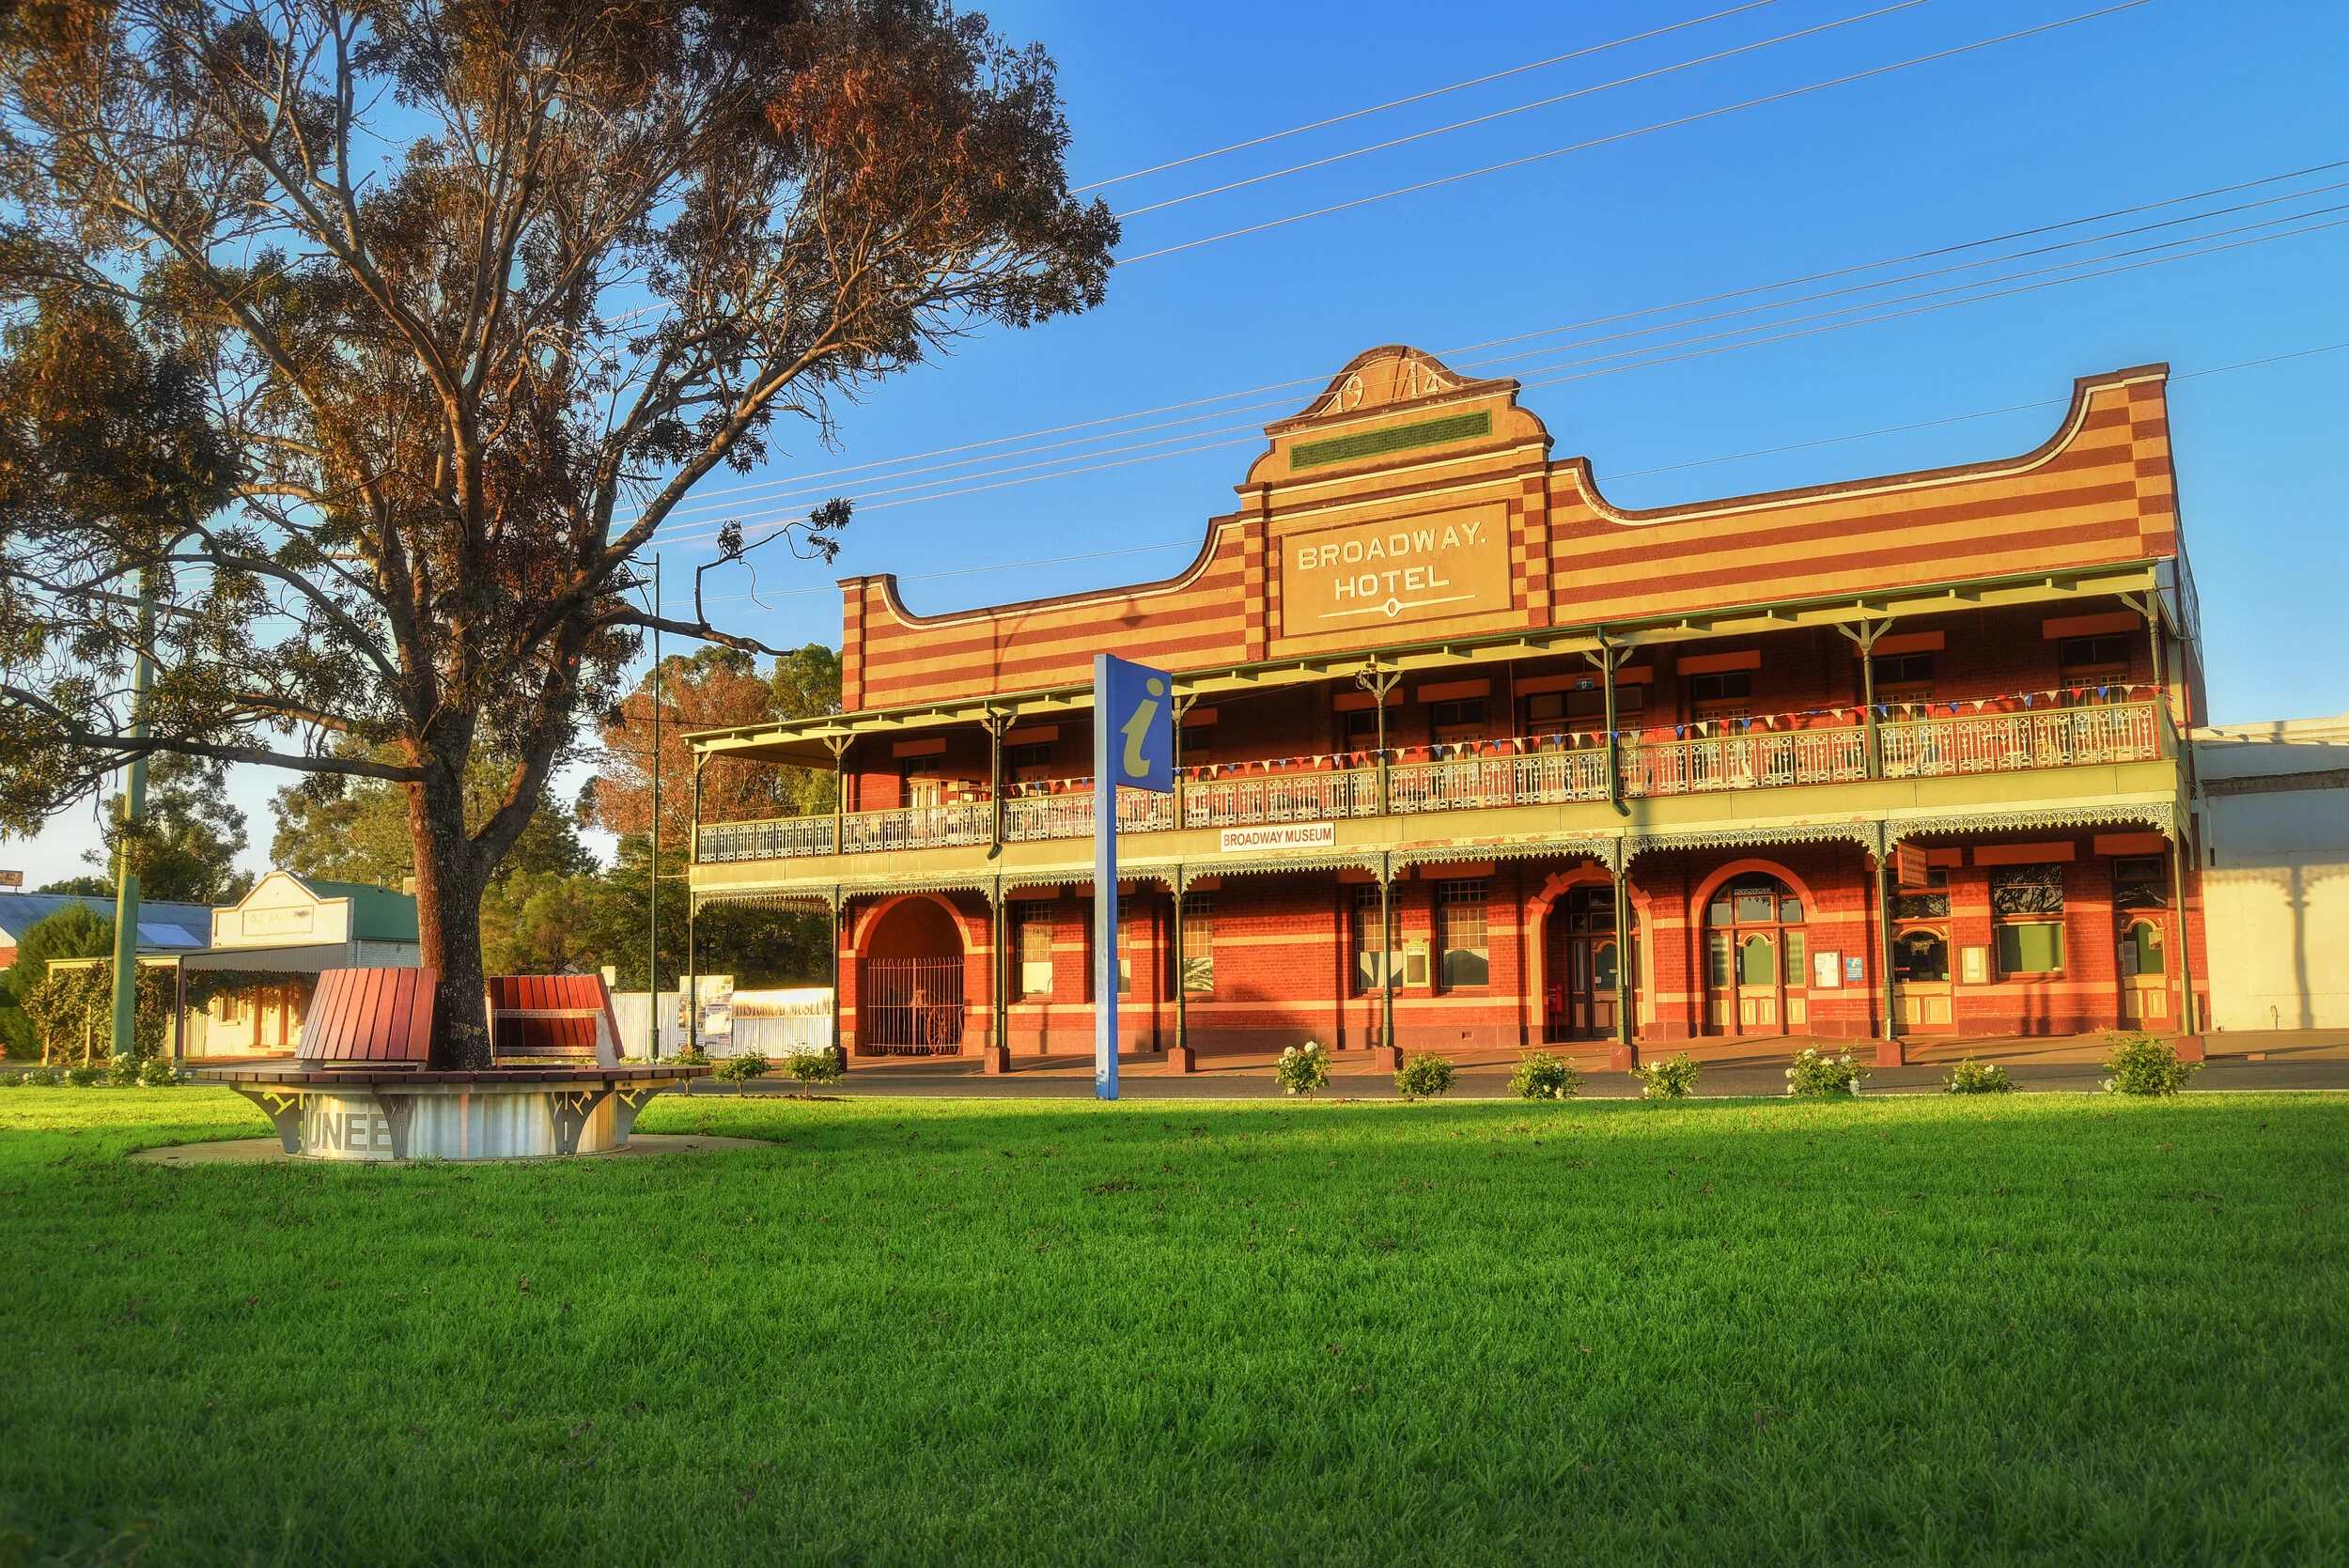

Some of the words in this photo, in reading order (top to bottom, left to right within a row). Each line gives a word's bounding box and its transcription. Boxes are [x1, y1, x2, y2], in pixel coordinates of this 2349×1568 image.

[1334, 565, 1451, 601] HOTEL
[1223, 831, 1283, 846] BROADWAY
[1284, 828, 1332, 843] MUSEUM
[789, 996, 831, 1016] MUSEUM
